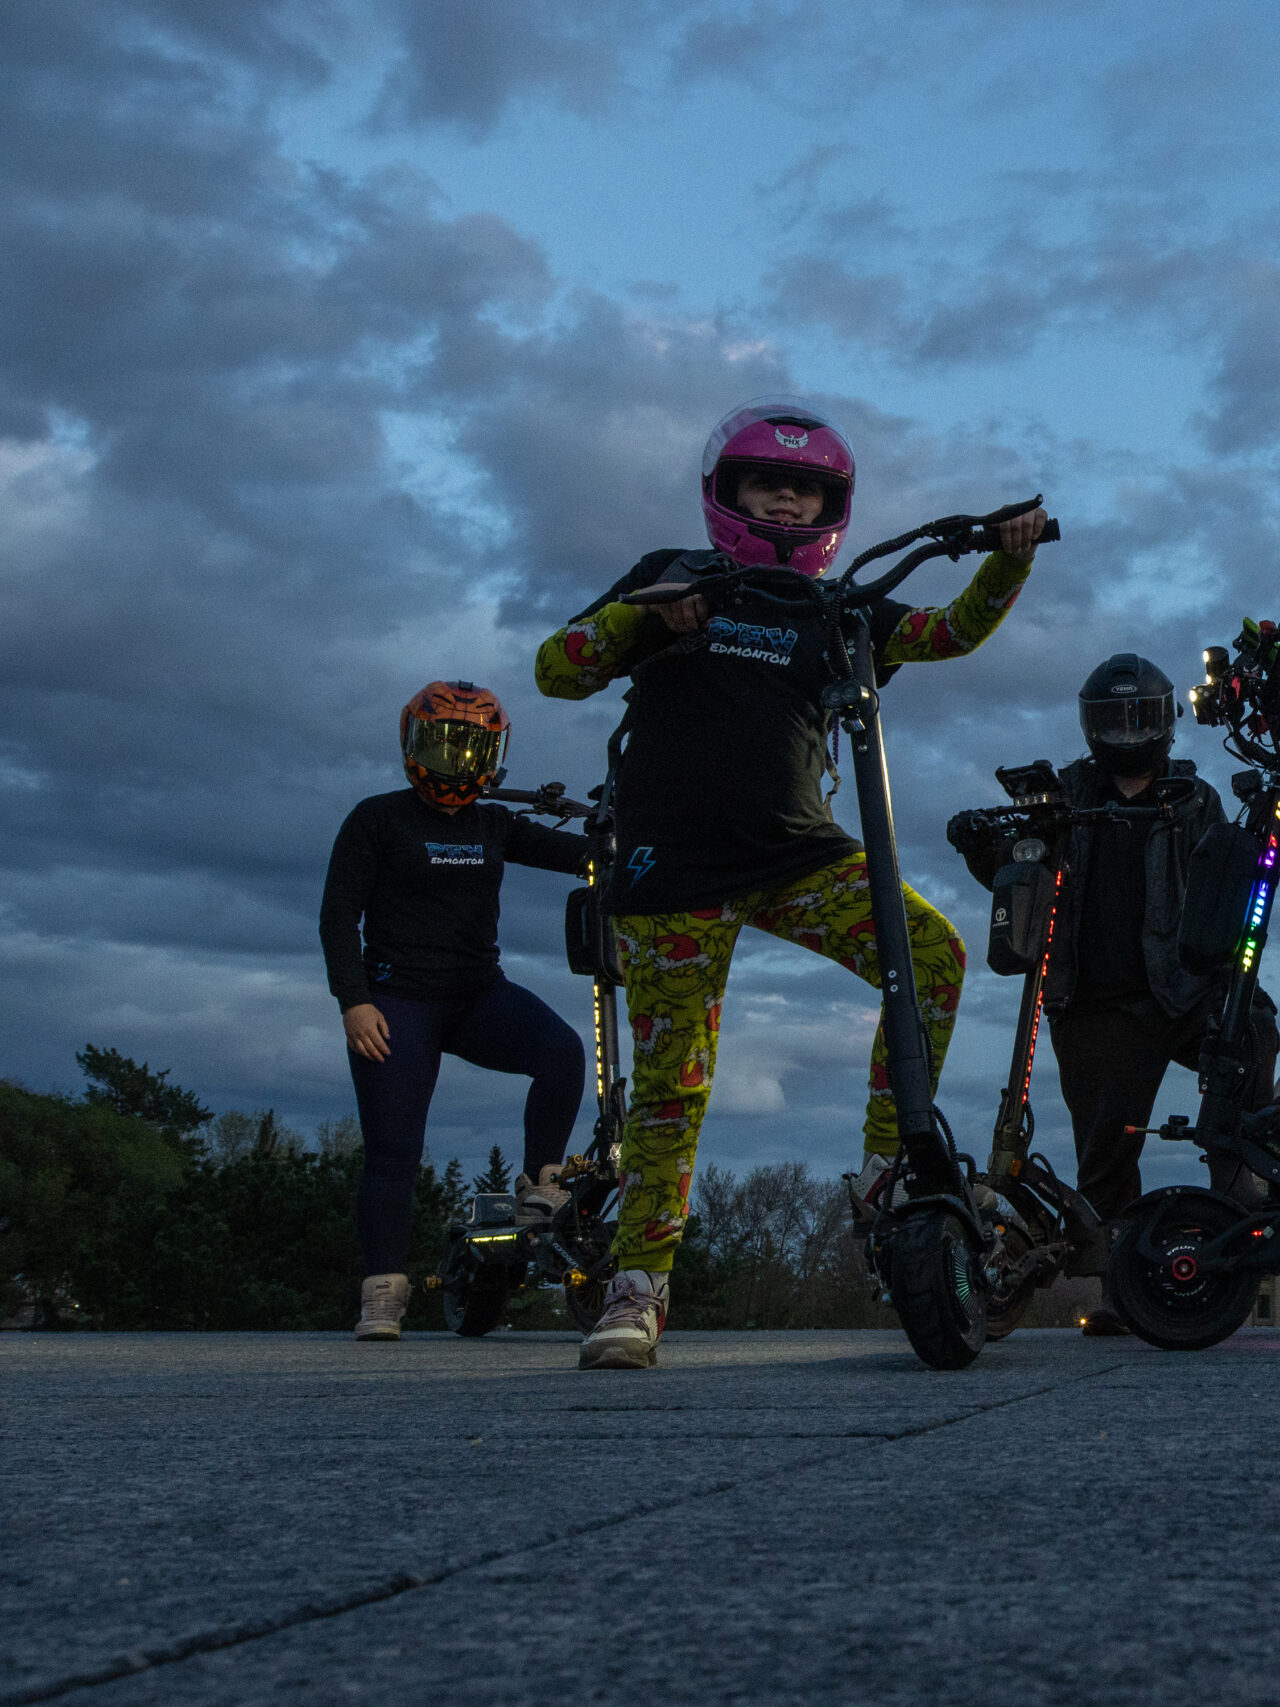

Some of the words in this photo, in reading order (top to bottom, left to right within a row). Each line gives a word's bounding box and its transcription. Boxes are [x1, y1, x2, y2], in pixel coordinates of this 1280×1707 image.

[783, 438, 801, 446] PHX
[706, 616, 799, 655] PEV
[709, 642, 792, 666] EDMONTON
[430, 857, 485, 865] EDMONTON
